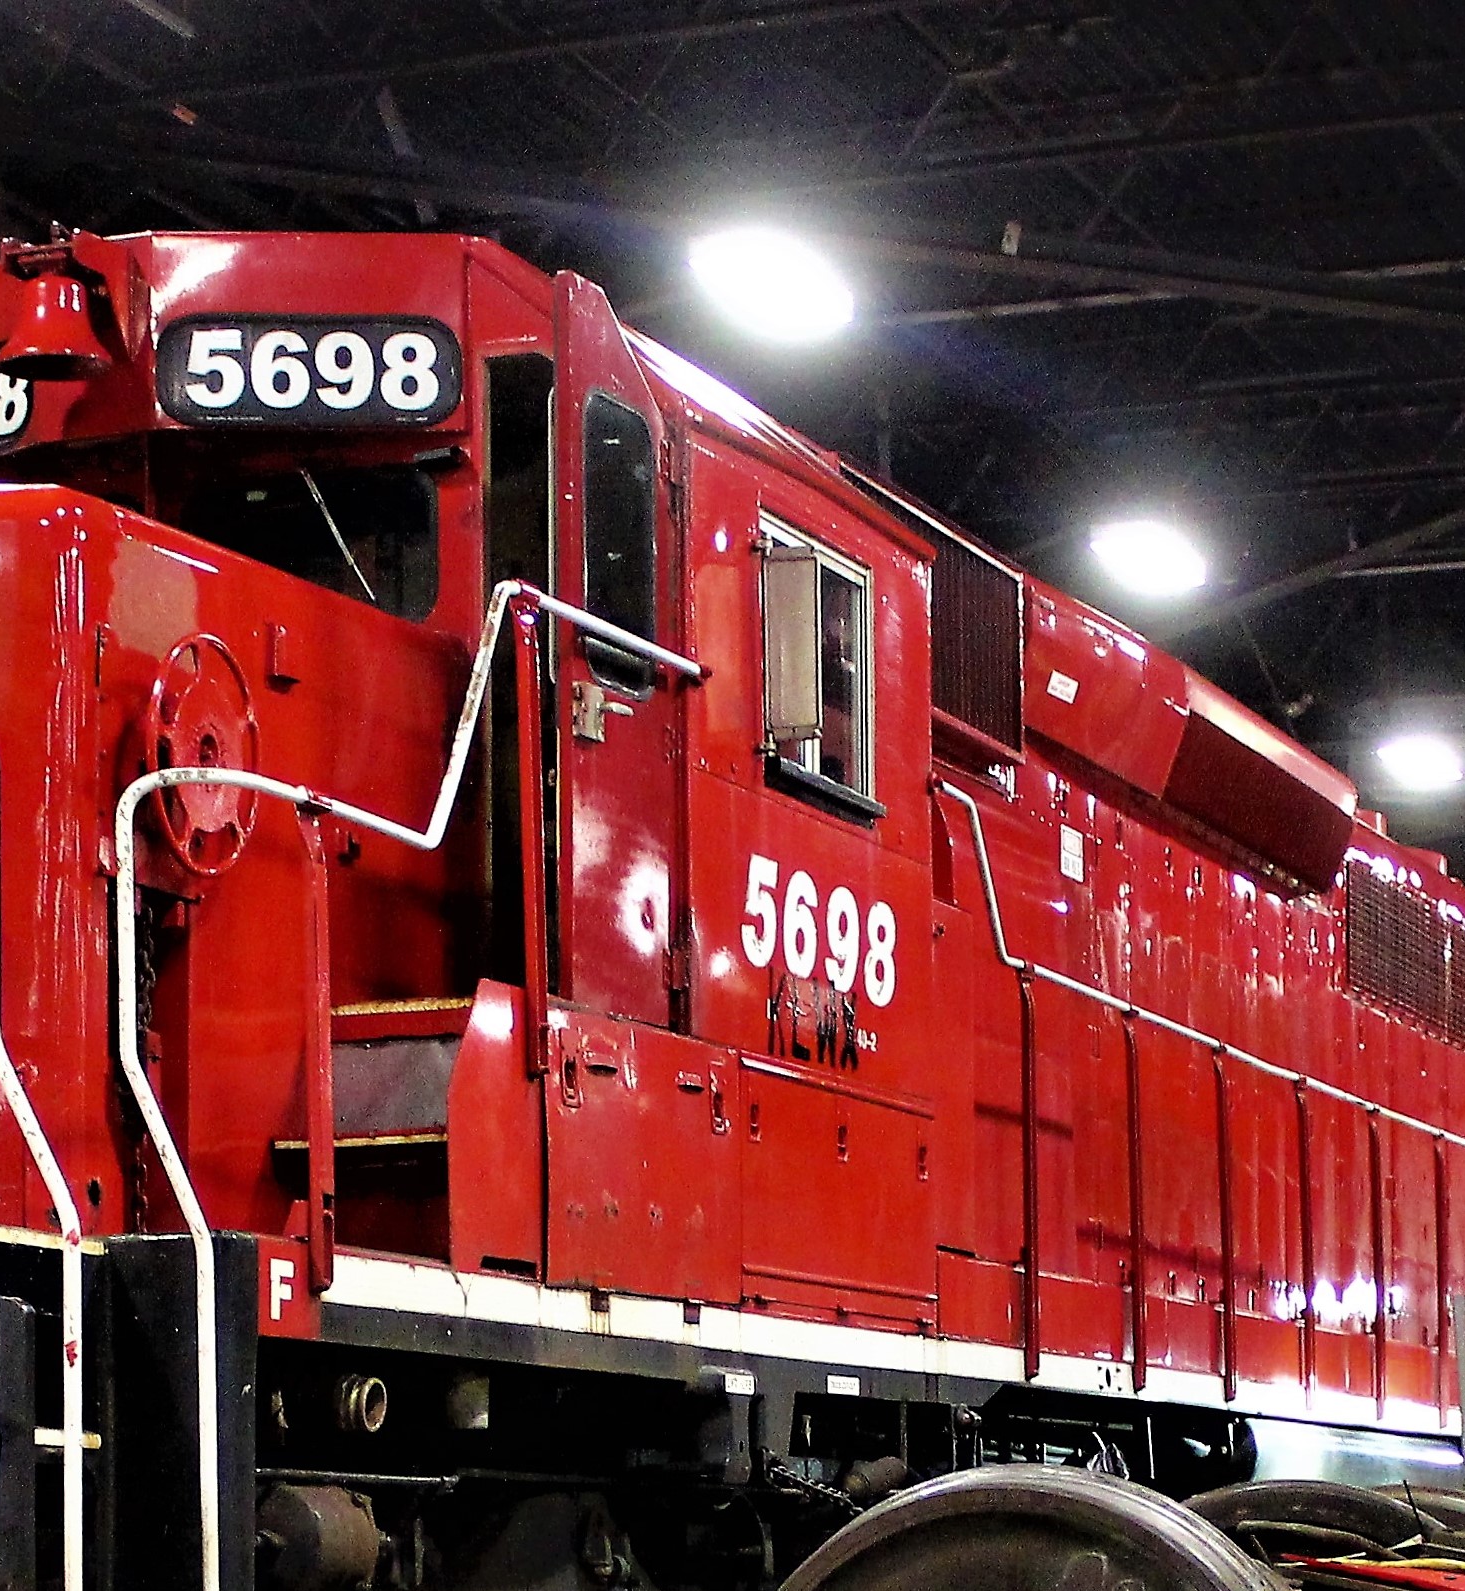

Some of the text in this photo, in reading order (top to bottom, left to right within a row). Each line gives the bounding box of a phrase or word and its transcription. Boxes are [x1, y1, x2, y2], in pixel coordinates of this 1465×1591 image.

[185, 328, 440, 411] 5698
[741, 854, 897, 1007] 5698
[269, 1258, 294, 1321] F
